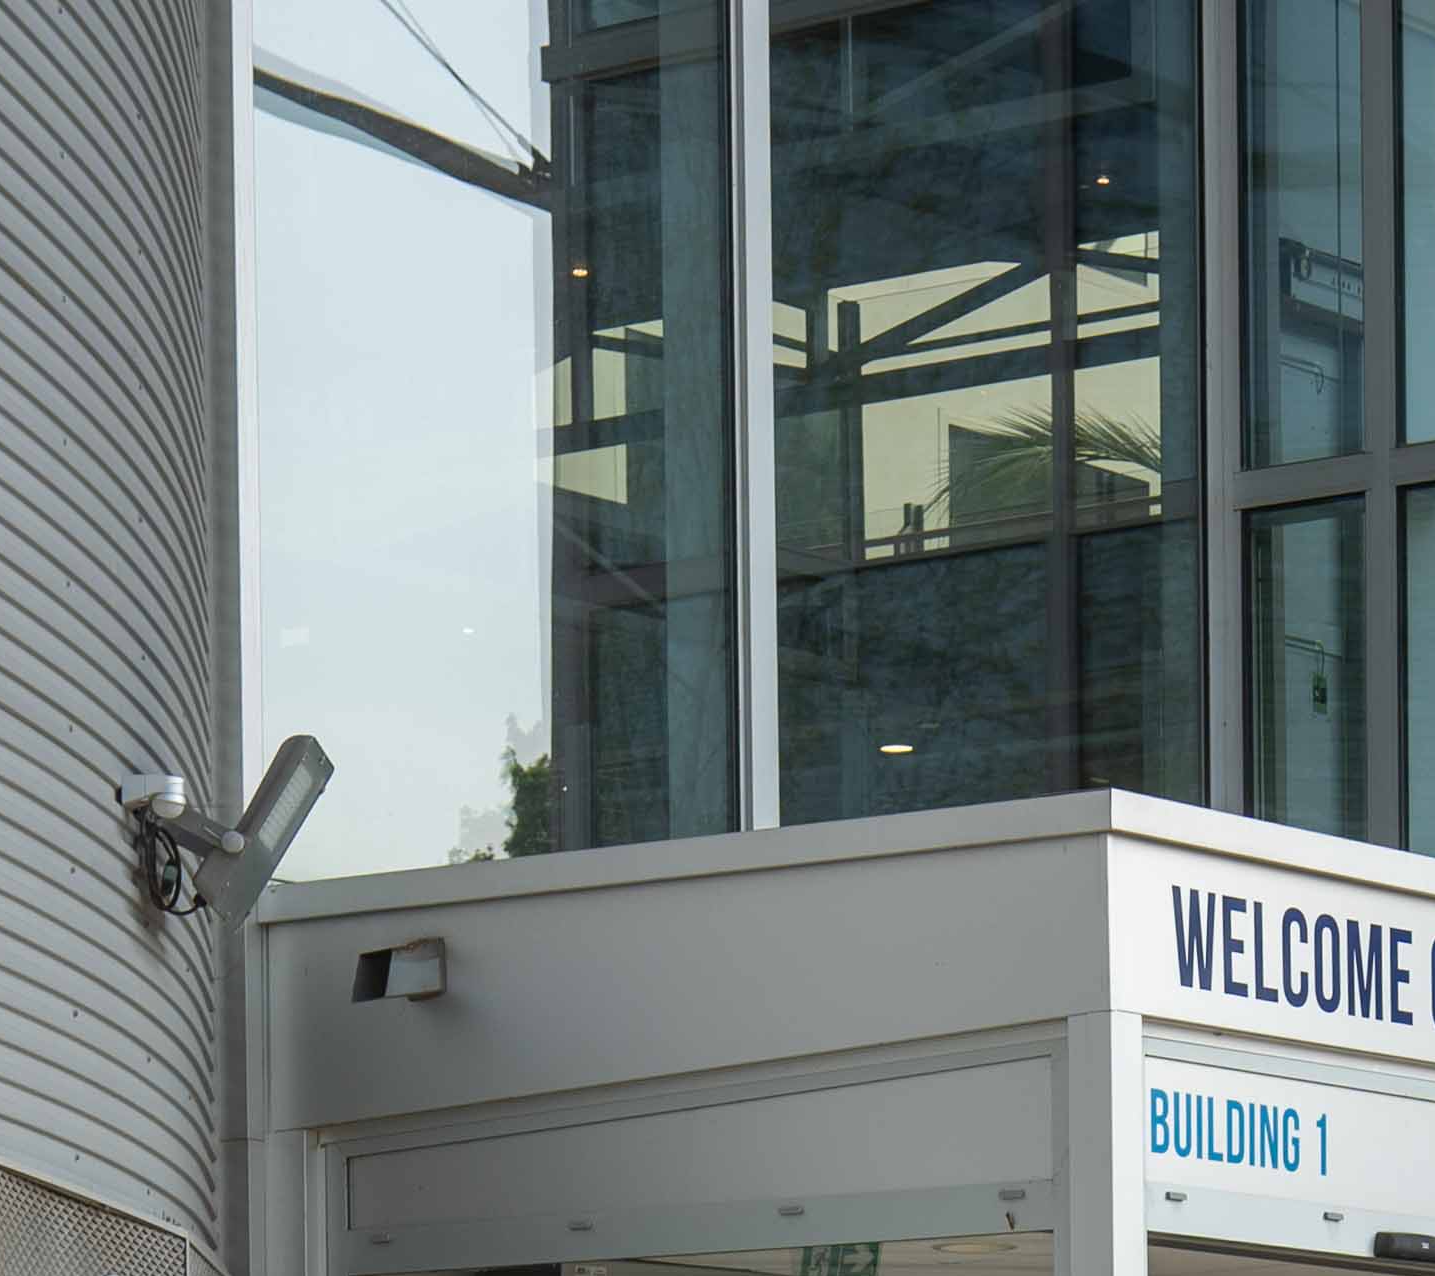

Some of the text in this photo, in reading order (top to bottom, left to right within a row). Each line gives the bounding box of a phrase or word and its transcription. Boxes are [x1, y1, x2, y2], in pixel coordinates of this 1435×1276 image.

[1170, 884, 1414, 1027] WELCOME
[1149, 1087, 1329, 1177] BUILDING 1
